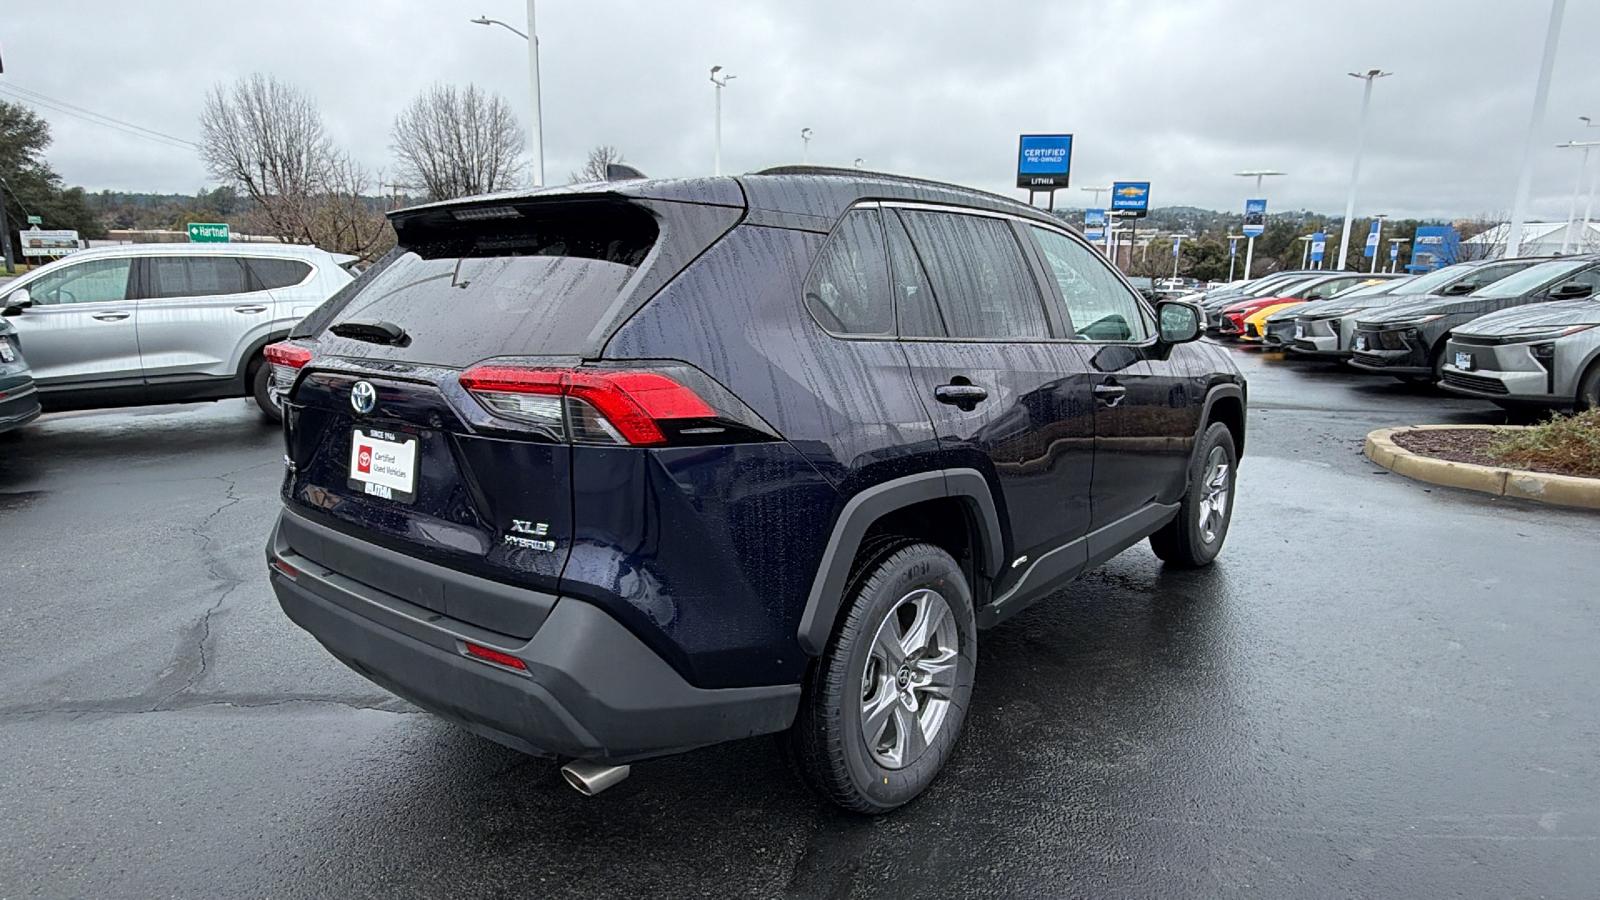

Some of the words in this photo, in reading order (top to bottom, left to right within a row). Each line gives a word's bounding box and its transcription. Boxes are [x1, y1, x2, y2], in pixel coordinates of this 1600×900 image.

[199, 226, 228, 237] Hartnell
[370, 429, 384, 439] SINCE
[384, 432, 396, 441] 1946
[374, 452, 396, 464] Certified
[373, 464, 386, 474] Used
[386, 467, 406, 479] Vehicles
[510, 519, 549, 536] XLE
[505, 534, 546, 551] HYBRID
